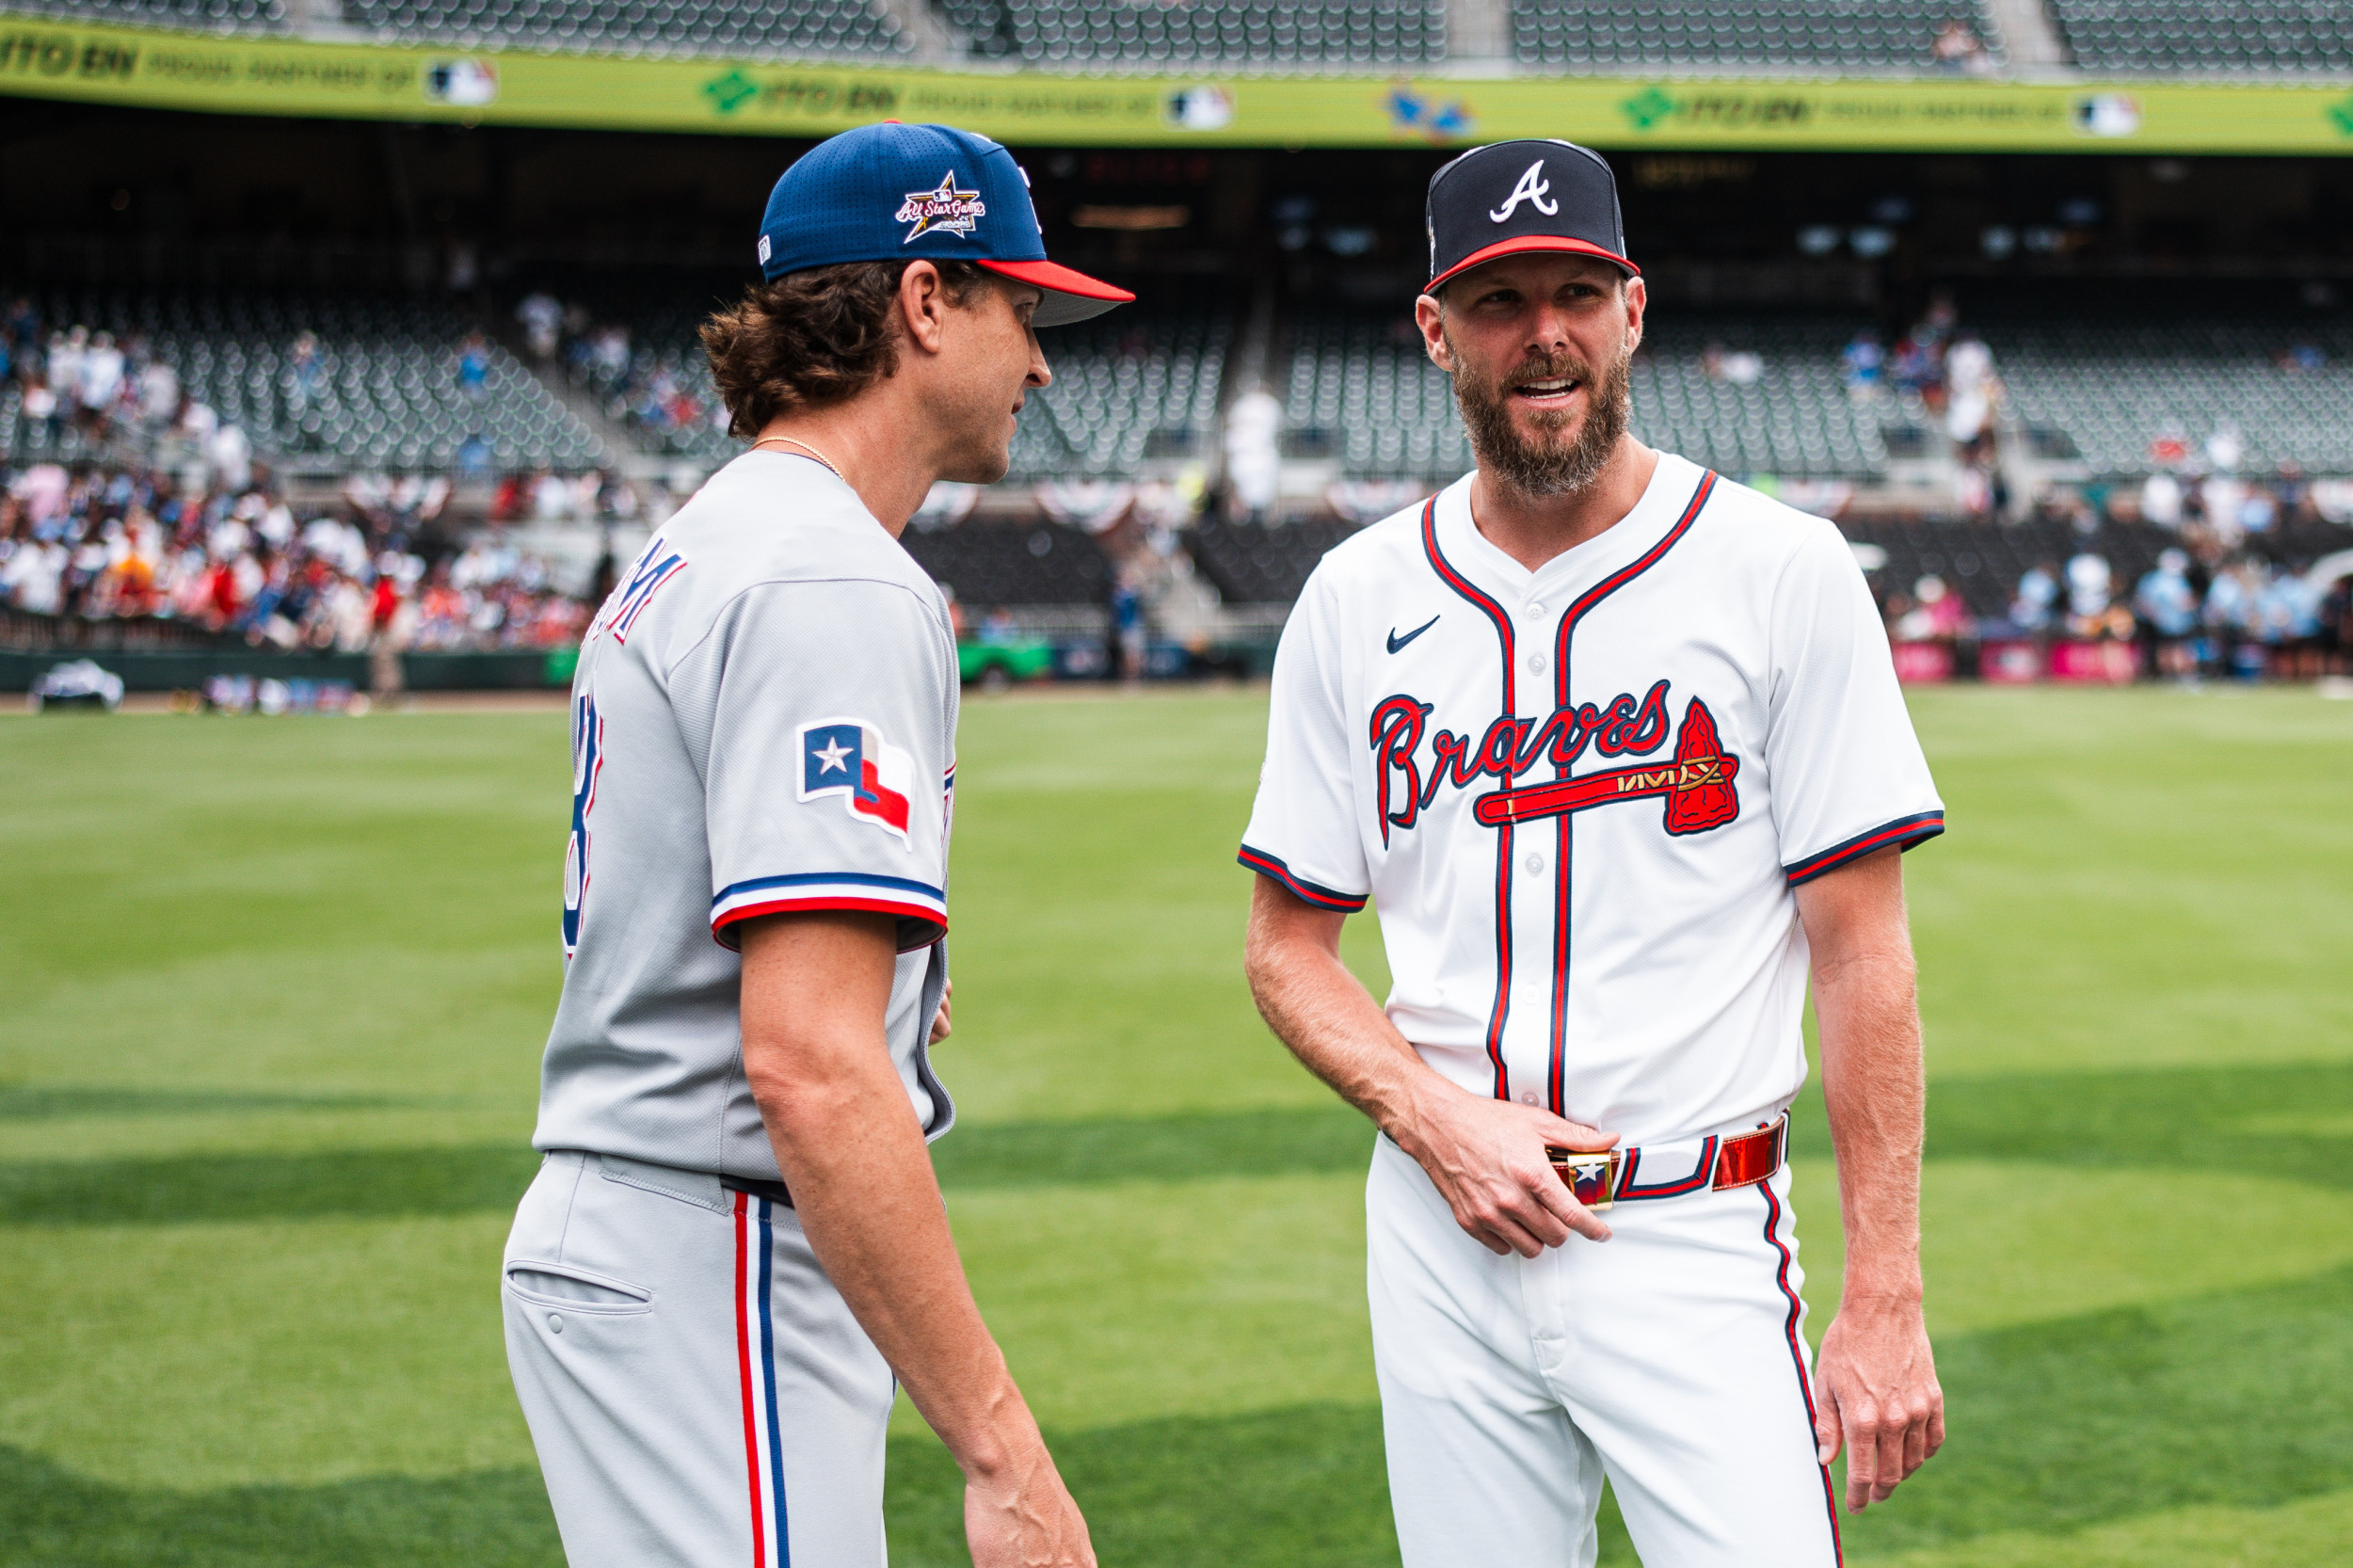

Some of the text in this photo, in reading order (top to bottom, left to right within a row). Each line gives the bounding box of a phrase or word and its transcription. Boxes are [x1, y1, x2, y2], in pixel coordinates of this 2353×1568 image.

[896, 200, 984, 220] All Star Game
[1489, 159, 1559, 223] A
[1369, 679, 1671, 851] Braves
